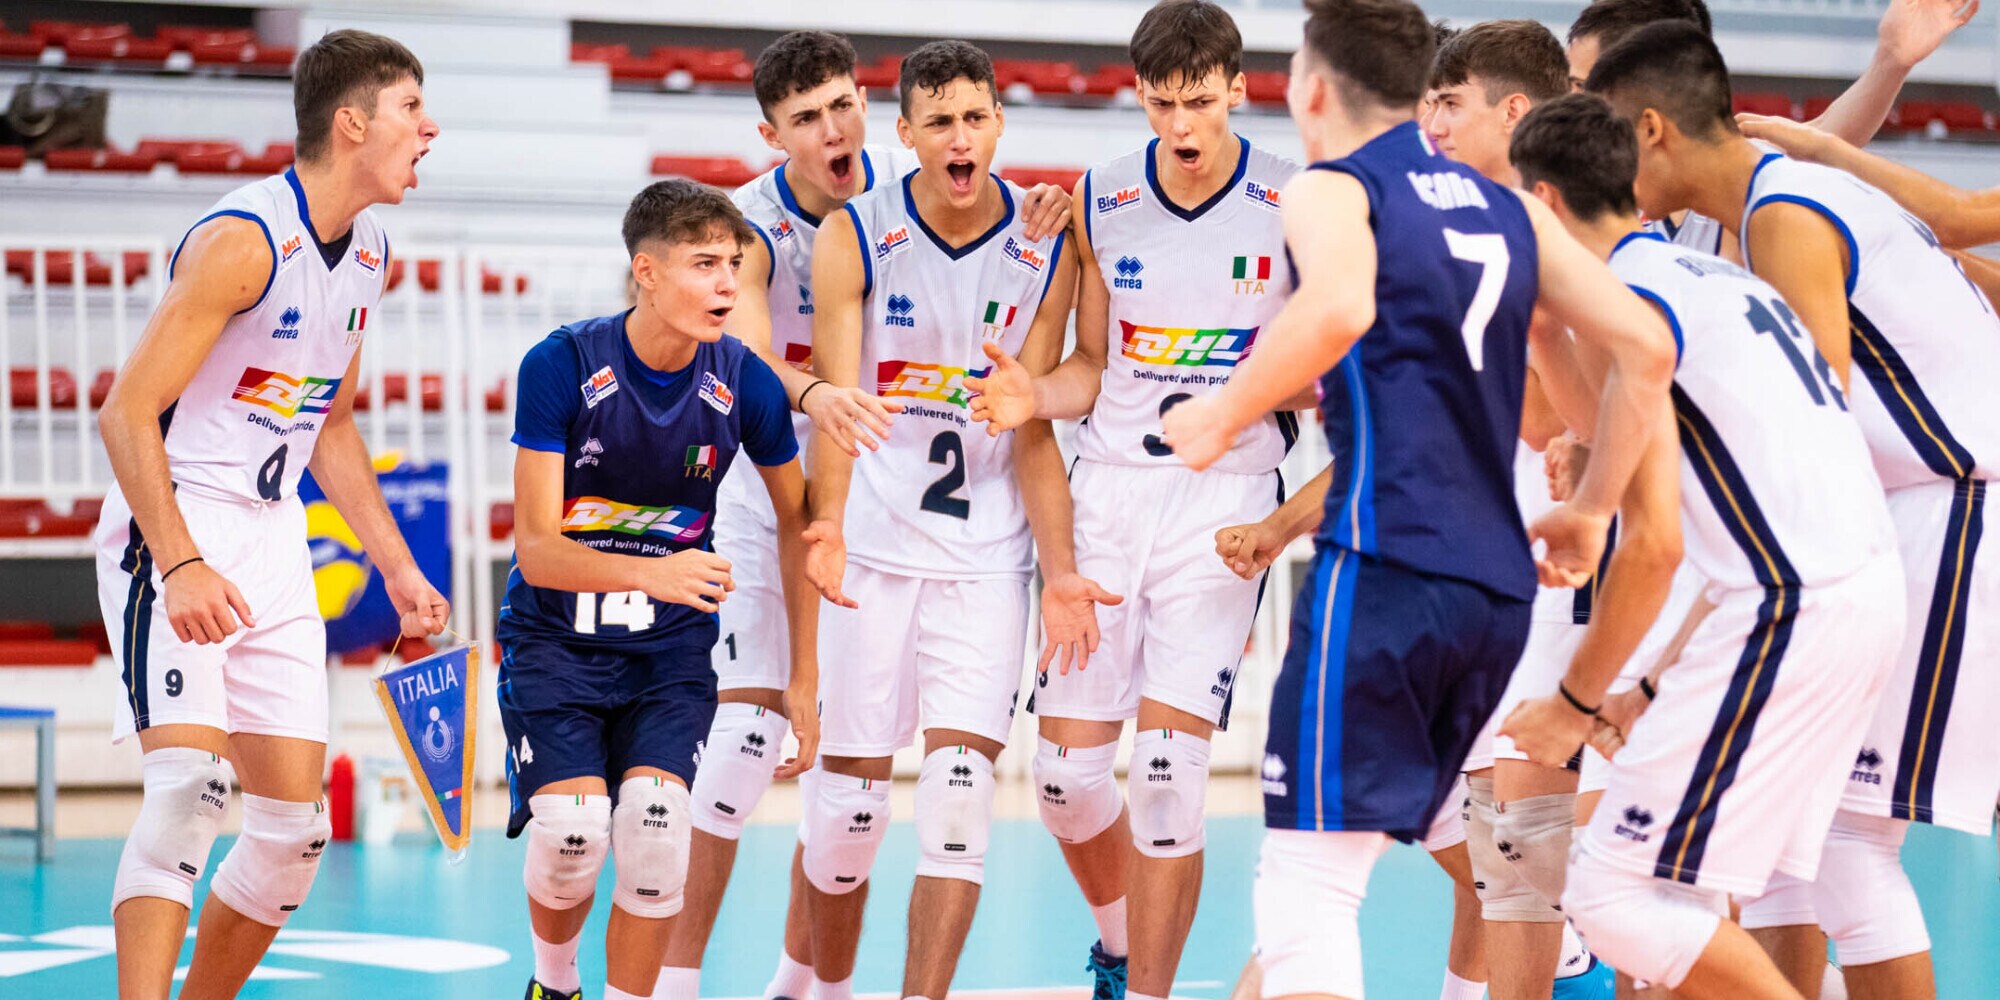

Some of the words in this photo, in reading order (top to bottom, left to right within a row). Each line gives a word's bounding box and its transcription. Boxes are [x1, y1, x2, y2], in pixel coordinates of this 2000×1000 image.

[1097, 187, 1140, 210] BigMat
[1246, 181, 1280, 203] BigM
[875, 227, 908, 255] igMat
[354, 249, 380, 268] gMat
[1004, 236, 1045, 268] BigMat
[1114, 277, 1142, 289] errea
[1235, 281, 1265, 295] ITA
[1443, 228, 1510, 372] 7
[272, 328, 298, 339] errea
[1133, 331, 1242, 361] DHL
[1133, 370, 1180, 383] Delivered
[1181, 374, 1206, 384] with
[1208, 376, 1229, 386] prid
[901, 405, 953, 421] Delivered
[247, 413, 287, 437] Deliver
[684, 466, 712, 482] ITA
[919, 430, 970, 520] 2
[567, 502, 686, 535] DHL
[615, 541, 640, 550] with
[574, 590, 655, 633] 14
[725, 633, 737, 661] 1
[165, 669, 183, 697] 9
[398, 663, 459, 704] ITALIA
[740, 745, 763, 758] errea
[949, 779, 972, 787] errea
[1148, 773, 1172, 782] errea
[1850, 770, 1881, 785] rrea
[201, 792, 224, 810] errea
[643, 819, 668, 828] errea
